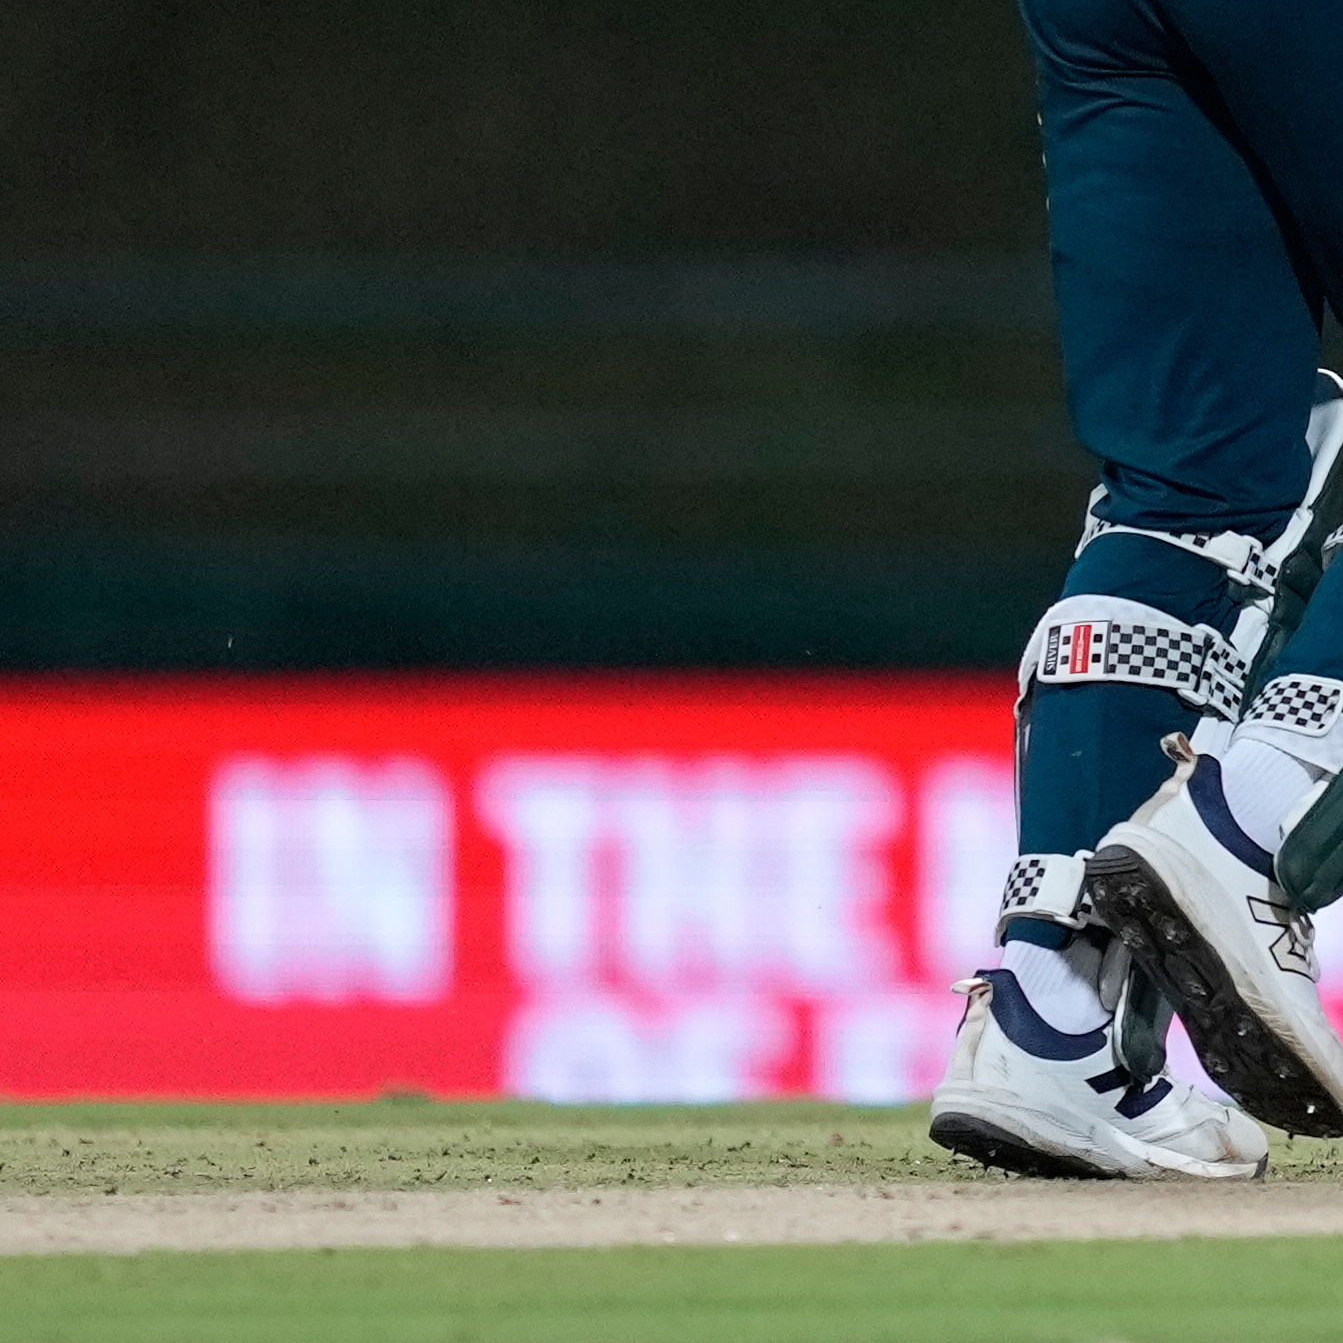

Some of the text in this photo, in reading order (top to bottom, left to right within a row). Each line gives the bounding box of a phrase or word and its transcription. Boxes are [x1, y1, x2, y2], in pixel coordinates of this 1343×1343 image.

[1046, 633, 1059, 672] SILVER
[210, 756, 453, 1003] IN
[474, 753, 902, 993] THE
